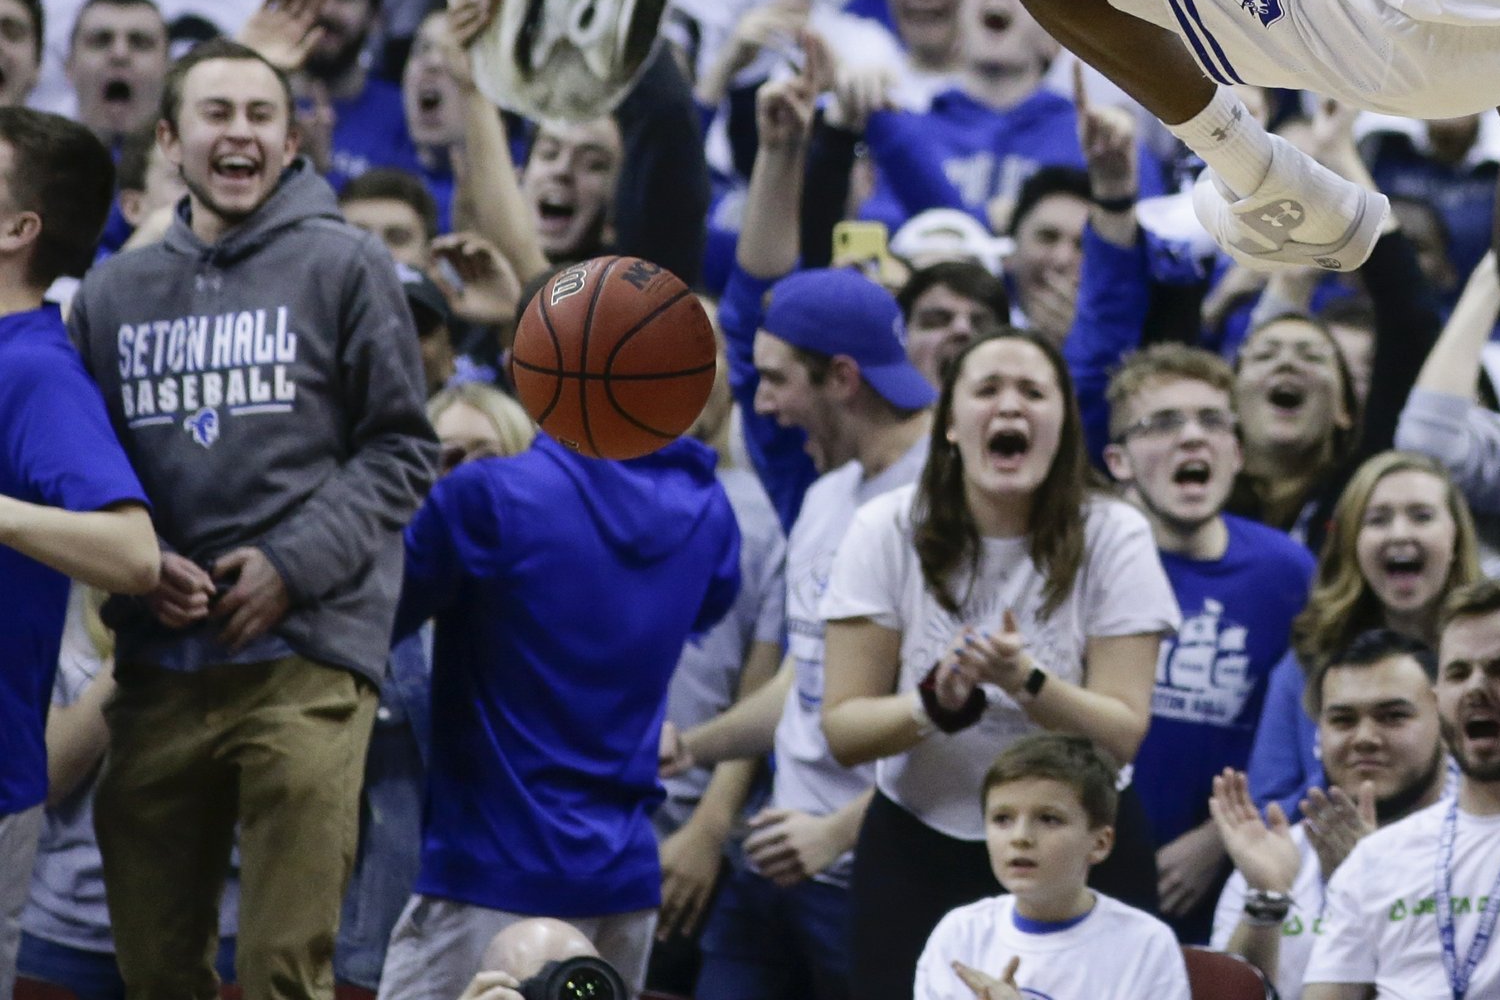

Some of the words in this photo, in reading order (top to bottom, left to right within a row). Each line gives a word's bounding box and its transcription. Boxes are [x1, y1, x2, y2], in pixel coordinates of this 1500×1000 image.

[117, 316, 209, 380] SETON
[210, 306, 298, 370] HALL
[121, 364, 297, 418] BASEBALL
